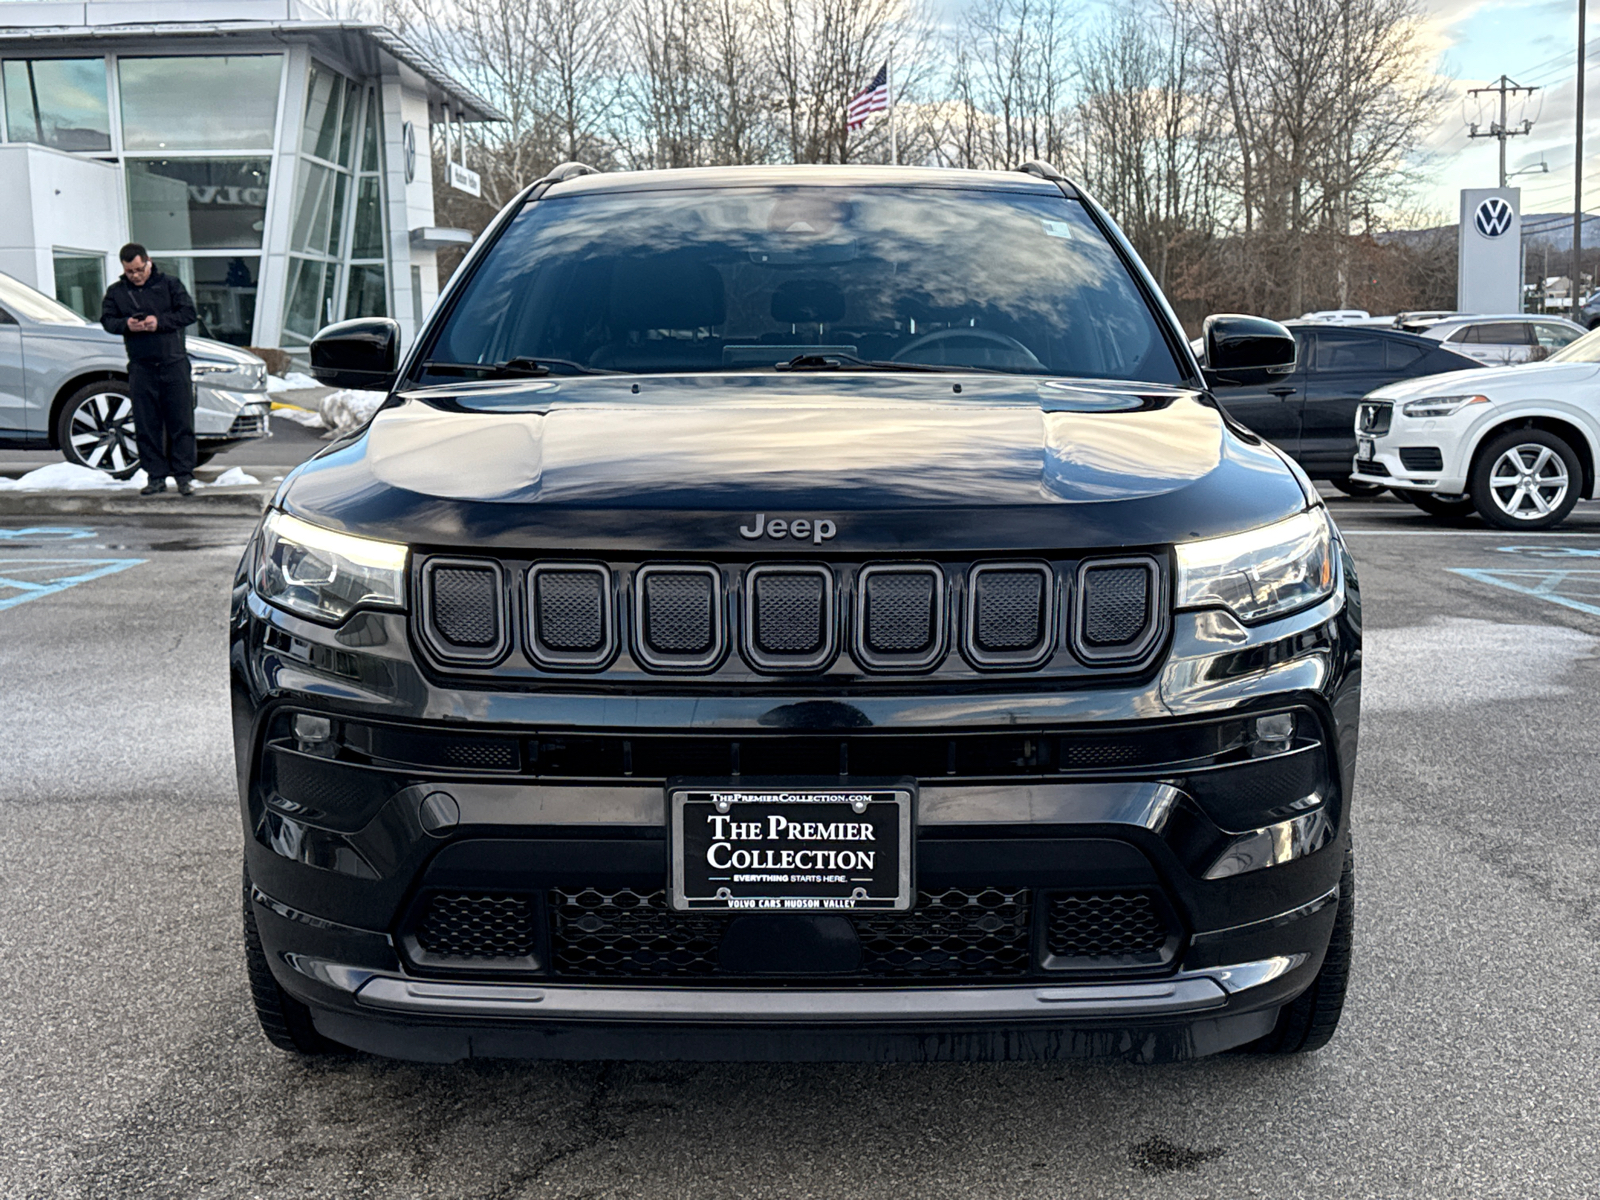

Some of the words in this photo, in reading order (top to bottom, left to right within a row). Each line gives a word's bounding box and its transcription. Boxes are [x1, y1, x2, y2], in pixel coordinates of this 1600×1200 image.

[740, 513, 836, 544] Jeep
[707, 814, 763, 840] THE
[767, 815, 876, 841] PREMIER
[706, 842, 875, 870] COLLECTION
[733, 874, 789, 882] EVERYTHING
[823, 875, 848, 883] HERE.
[728, 900, 756, 908] VOLVO
[758, 900, 781, 908] CARS
[784, 900, 820, 908] HUDSON
[823, 900, 855, 908] VALLEY
